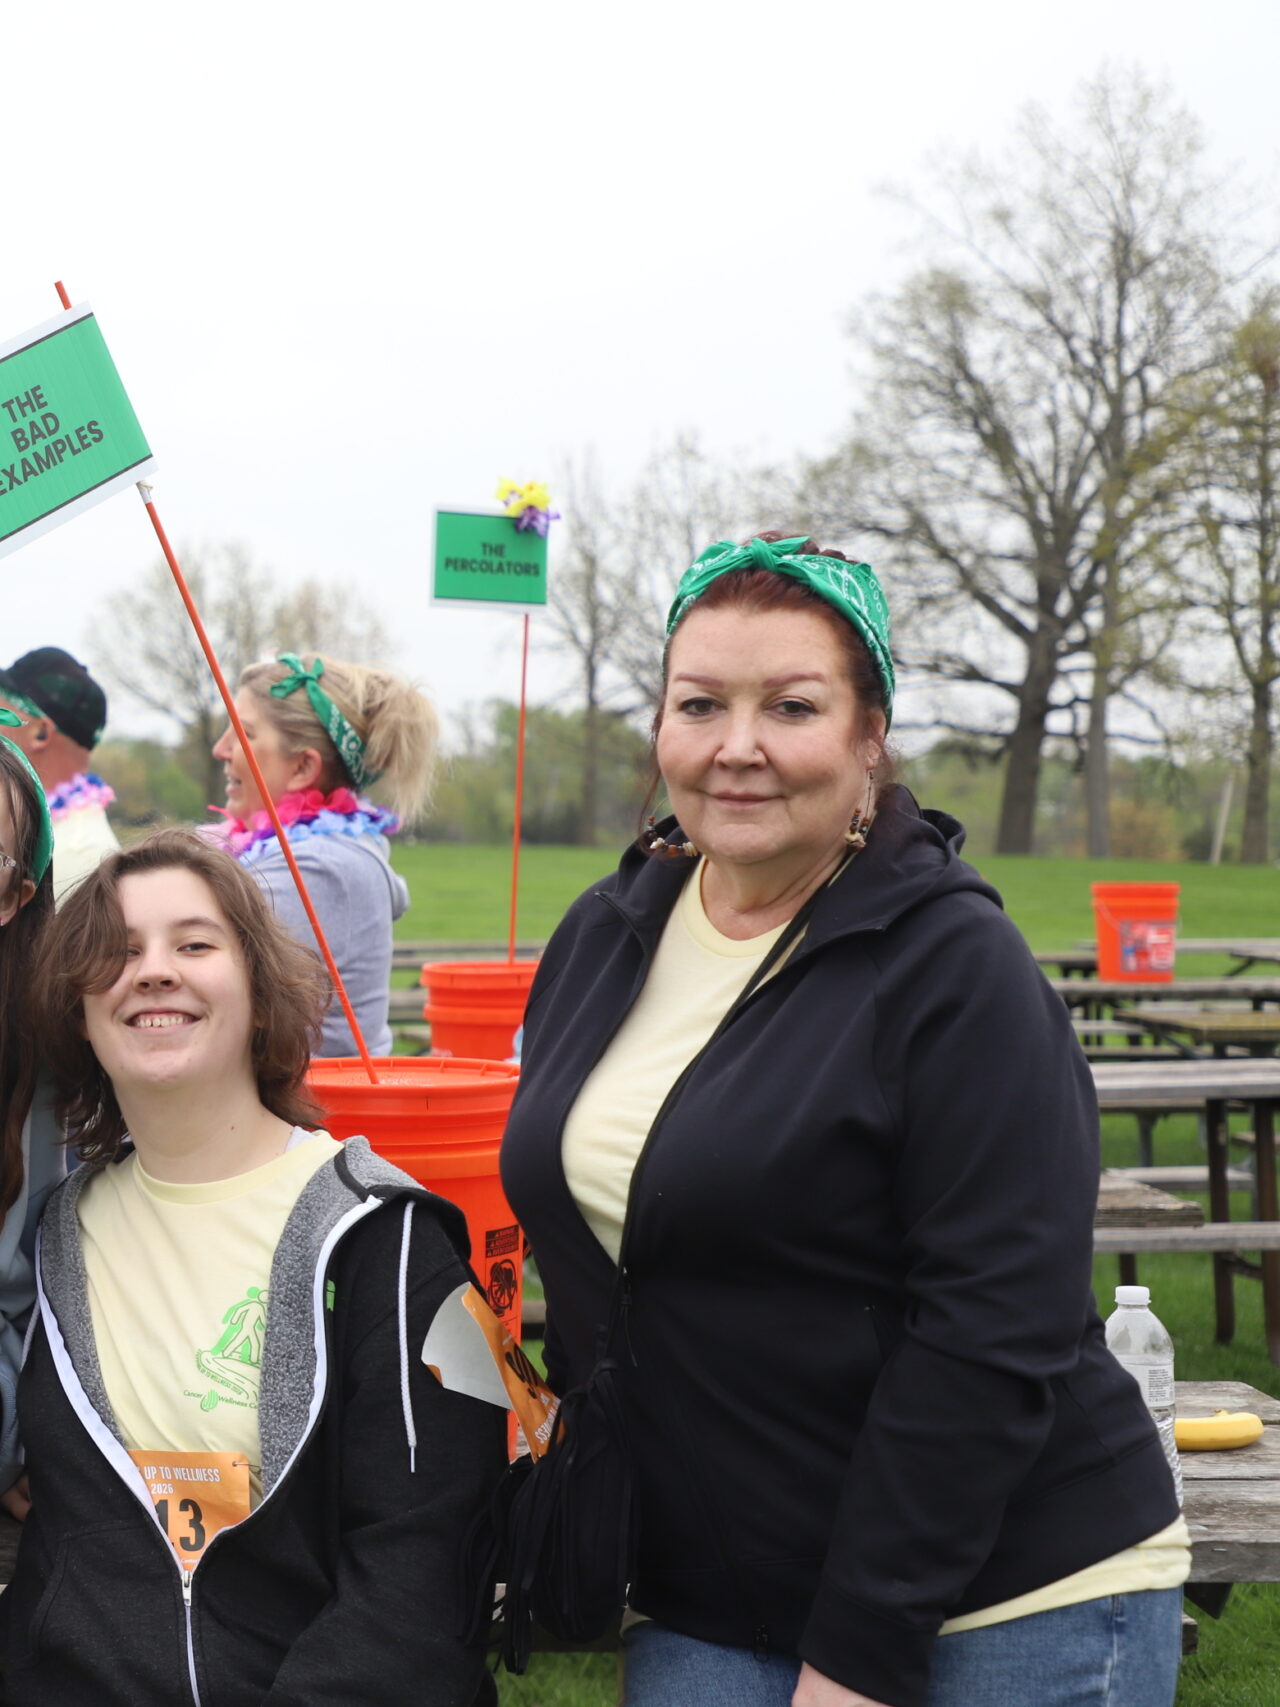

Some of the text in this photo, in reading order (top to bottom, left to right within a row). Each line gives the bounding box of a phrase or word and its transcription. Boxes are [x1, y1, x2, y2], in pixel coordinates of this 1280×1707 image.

[1, 385, 48, 423] THE
[11, 412, 60, 453] BAD
[481, 542, 506, 558] THE
[444, 556, 540, 577] PERCOLATORS
[183, 1389, 203, 1398] Cancer
[218, 1395, 248, 1408] Wellness
[144, 1466, 157, 1480] UP
[159, 1466, 172, 1480] TO
[172, 1467, 221, 1482] WELLNESS
[150, 1483, 174, 1495] 2026
